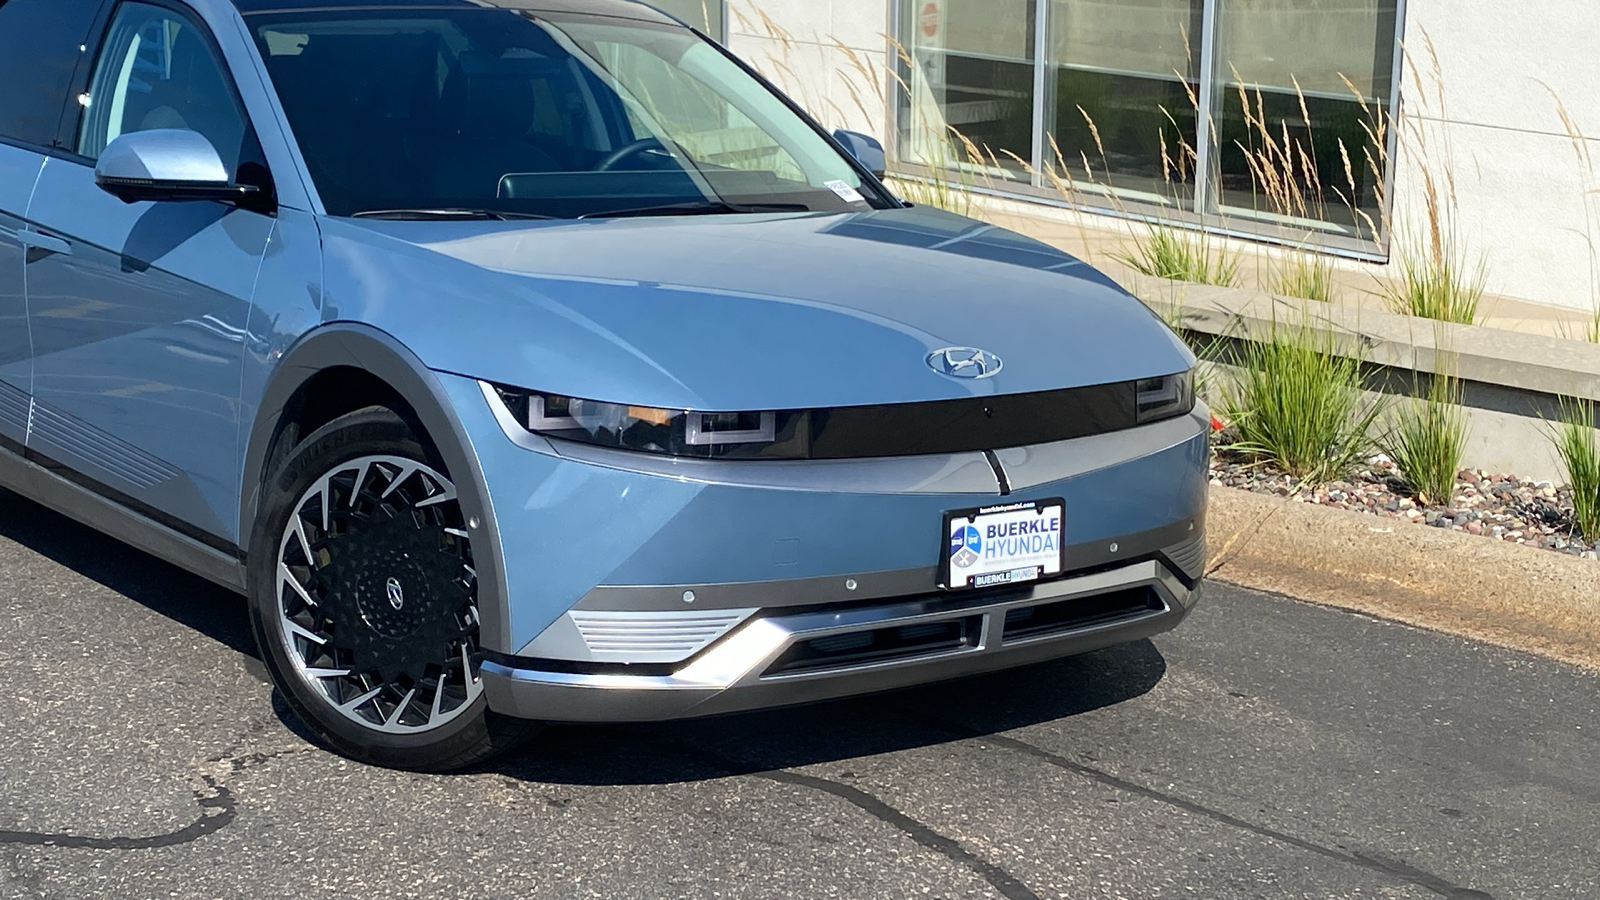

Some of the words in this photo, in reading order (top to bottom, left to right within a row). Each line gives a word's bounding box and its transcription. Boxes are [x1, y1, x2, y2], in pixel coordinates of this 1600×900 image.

[987, 517, 1059, 539] BUERKLE
[985, 533, 1059, 559] HYUNDAI
[976, 572, 1011, 586] BUERKLE
